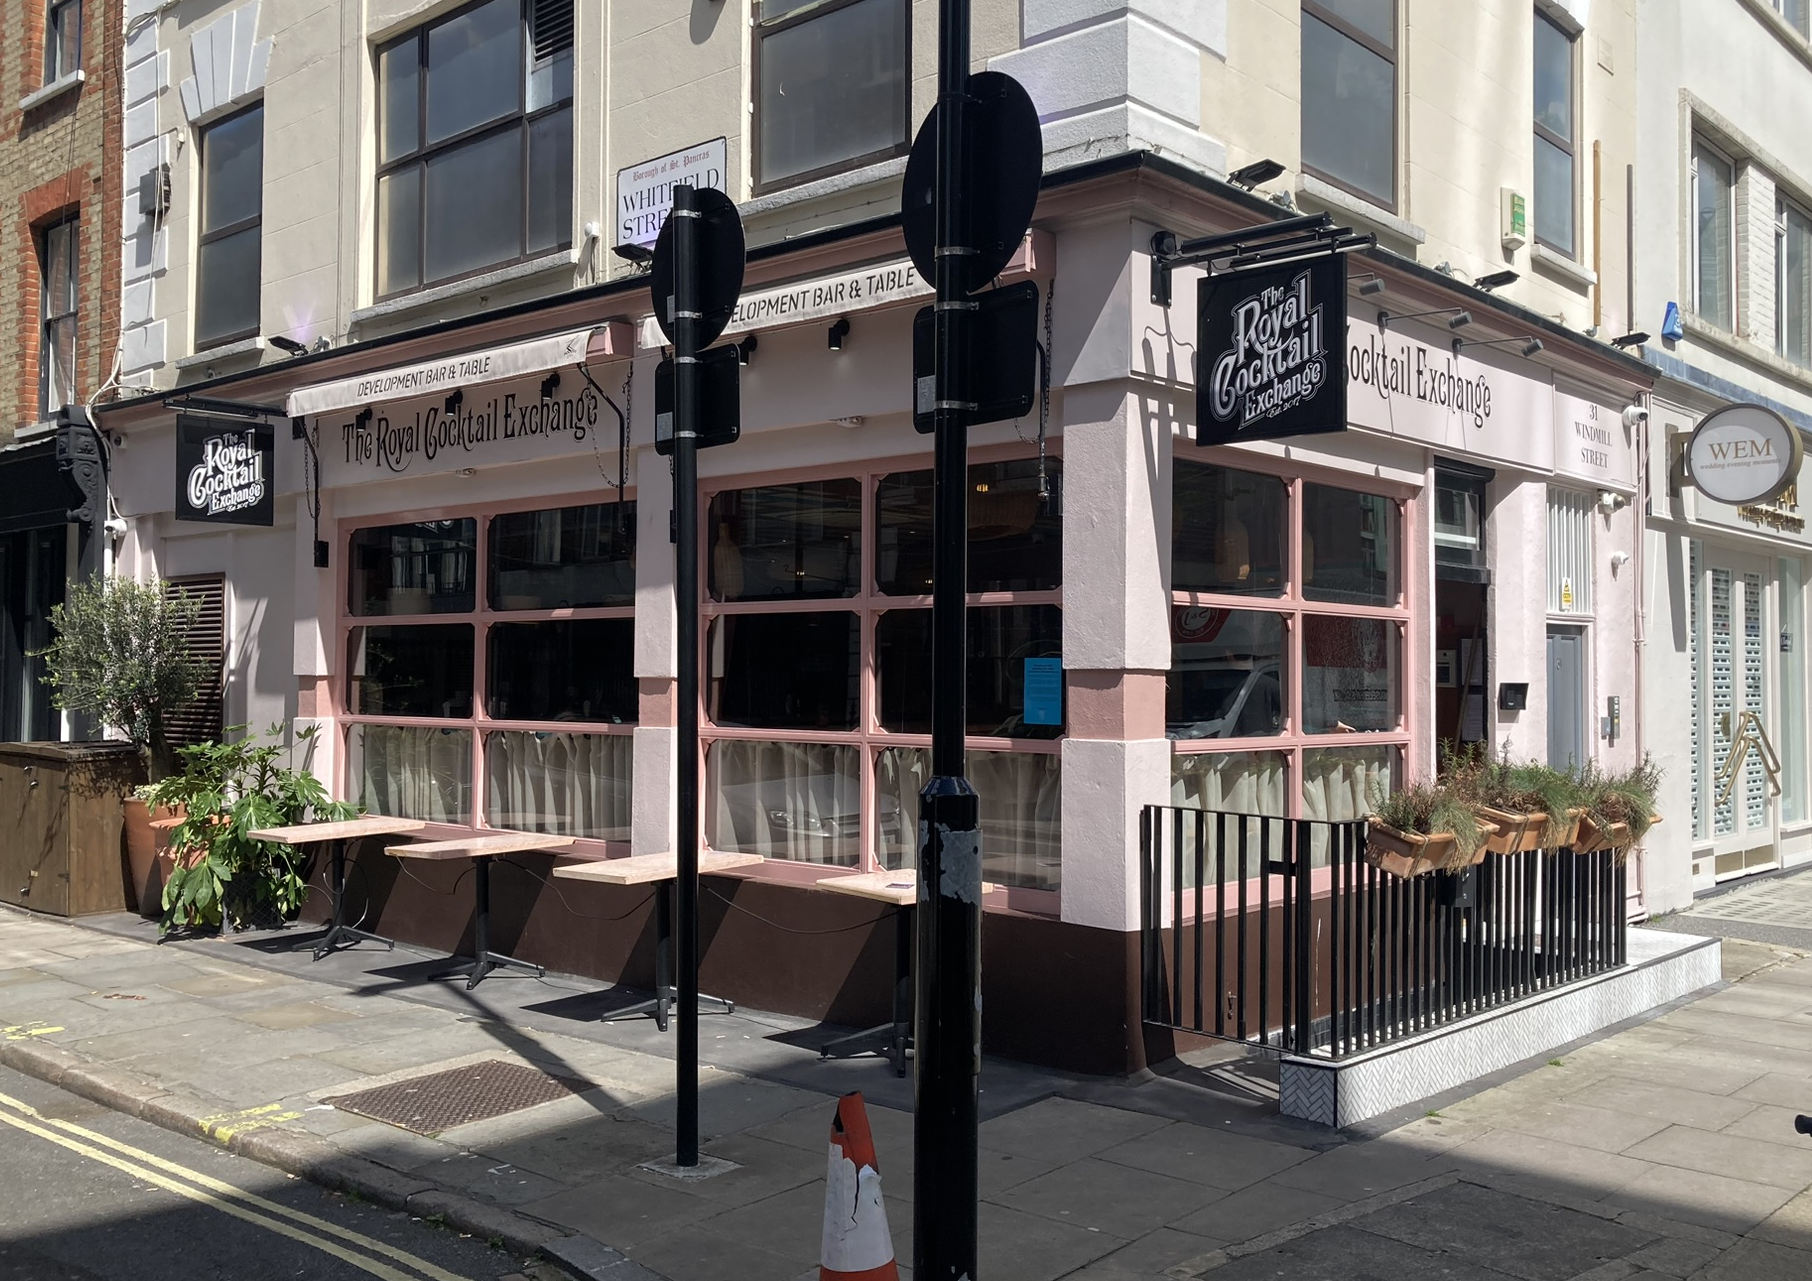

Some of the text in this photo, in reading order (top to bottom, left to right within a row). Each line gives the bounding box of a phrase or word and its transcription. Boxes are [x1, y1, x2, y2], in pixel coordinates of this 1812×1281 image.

[632, 167, 659, 182] Borough
[661, 163, 667, 173] of
[683, 151, 710, 168] Pancras
[623, 209, 668, 240] STRE
[813, 282, 845, 307] BAR
[849, 279, 862, 299] &
[866, 266, 915, 296] TABLE
[1261, 286, 1285, 310] The
[1236, 277, 1308, 367] Royal
[357, 356, 491, 397] DEVELOPMENT BAR & TABLE
[1213, 312, 1320, 415] Cocktail
[1350, 334, 1492, 429] ocktail Exchange
[1244, 362, 1321, 421] Exchange
[342, 387, 598, 473] The Royal Cocktail Exchange
[1589, 404, 1598, 421] 31
[223, 432, 239, 446] The
[1574, 421, 1612, 447] WINDMILL
[1708, 438, 1773, 460] WEM
[206, 430, 253, 477] Royal
[1581, 448, 1608, 469] STREET
[190, 455, 261, 506] Cocktail
[211, 483, 261, 511] Exchange
